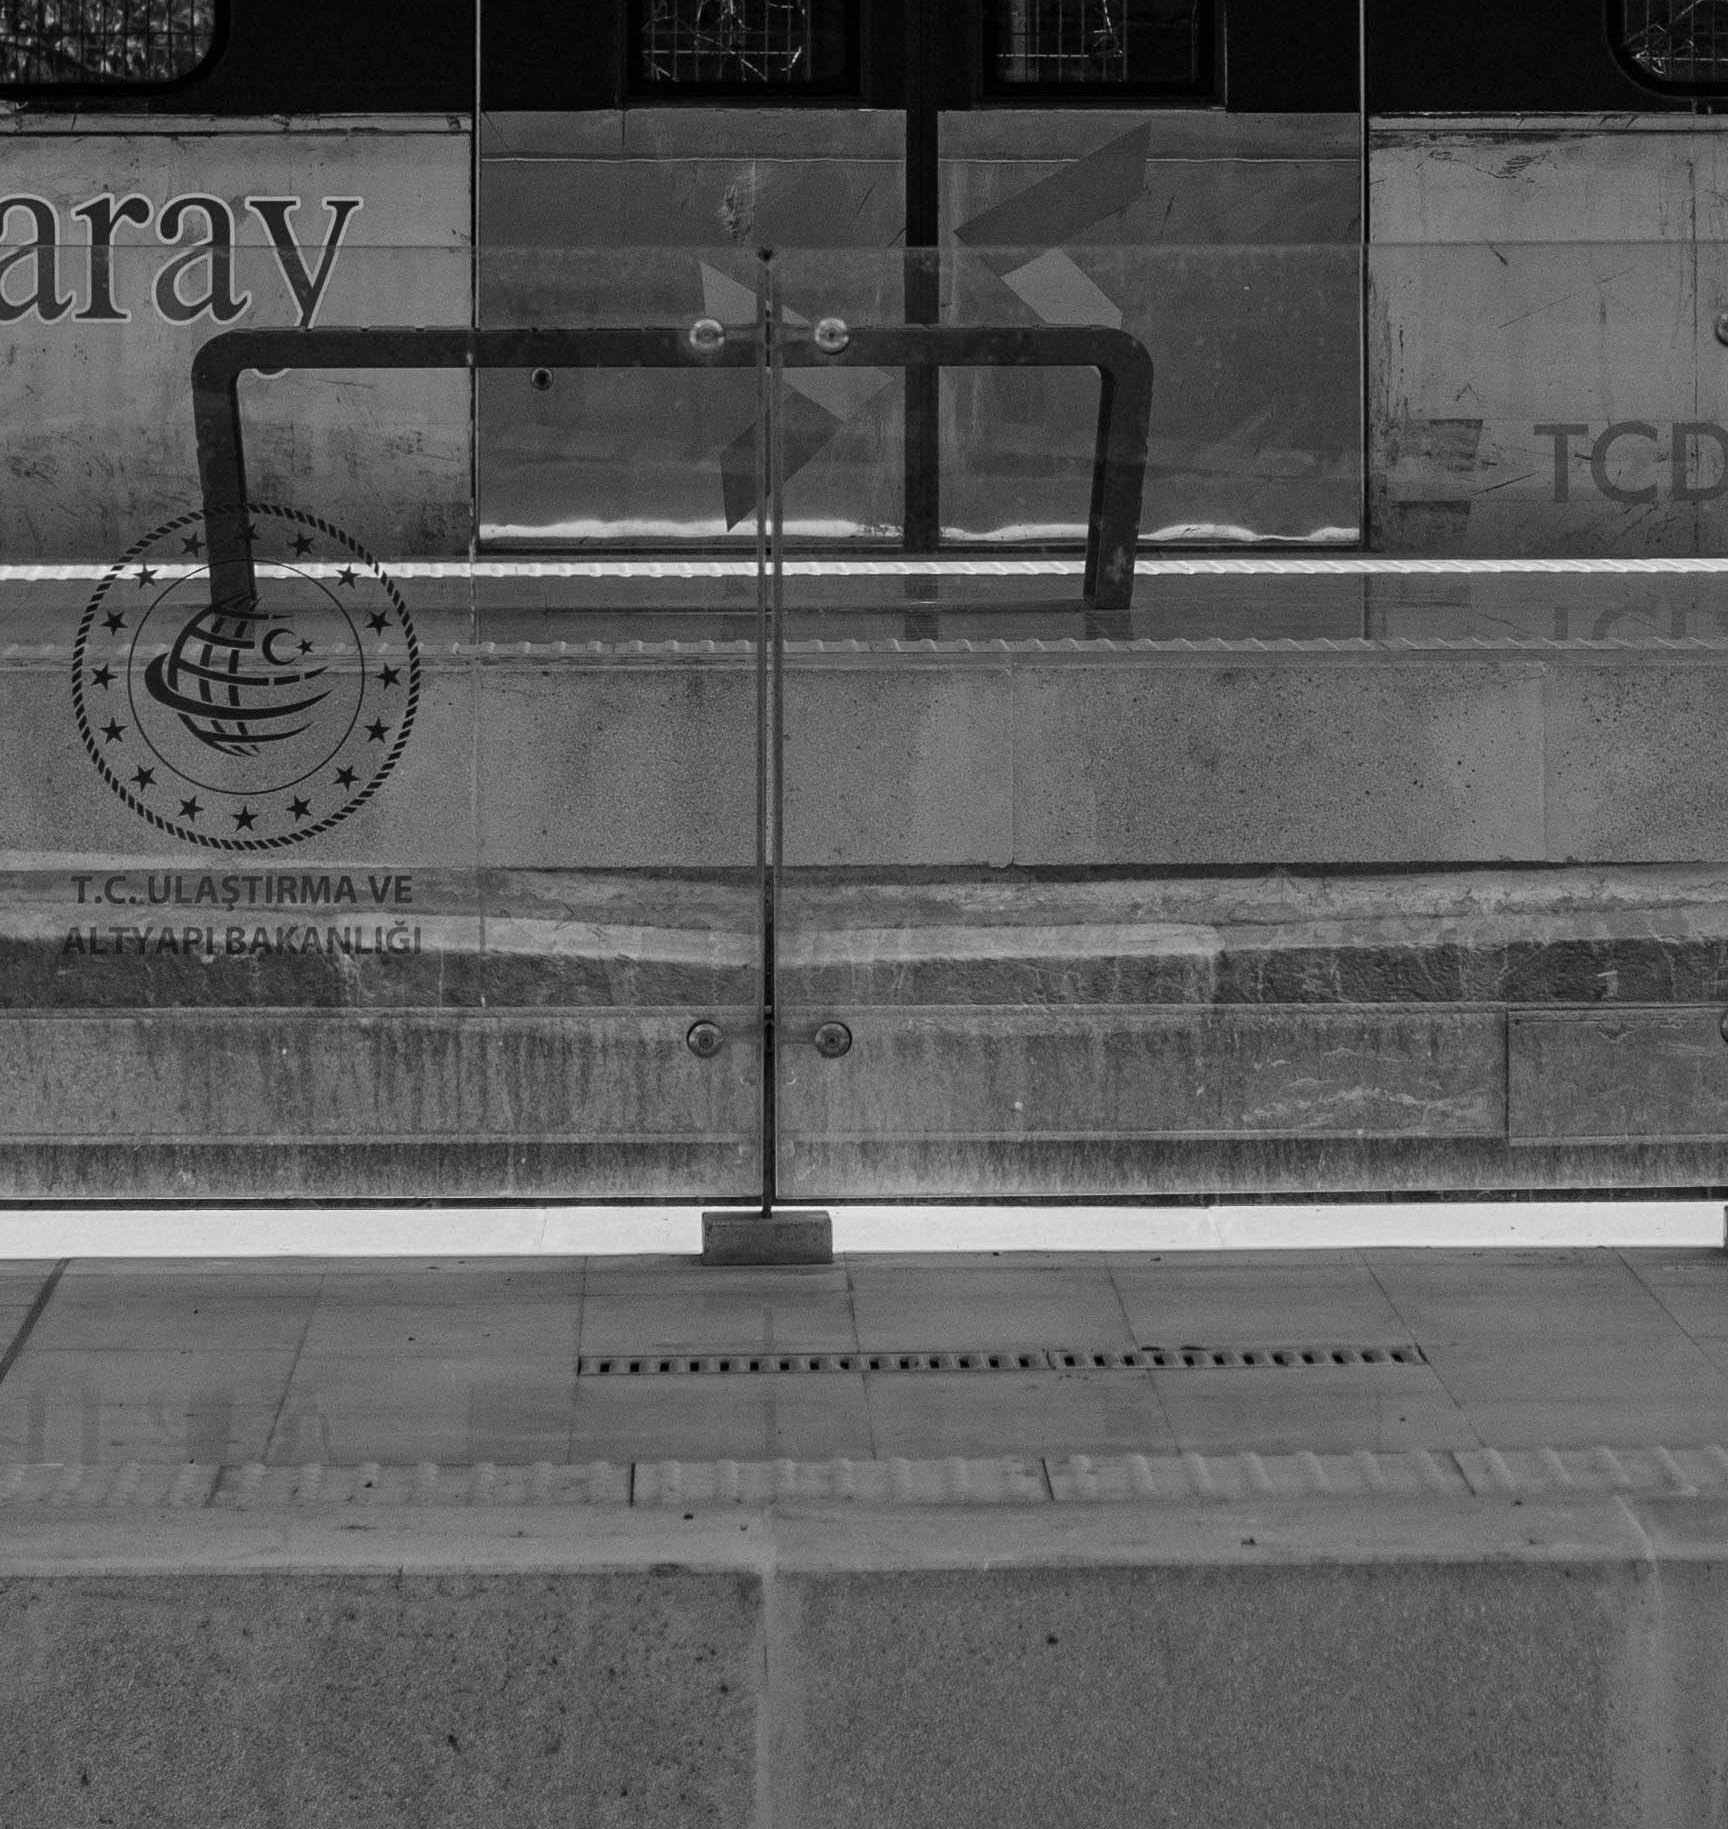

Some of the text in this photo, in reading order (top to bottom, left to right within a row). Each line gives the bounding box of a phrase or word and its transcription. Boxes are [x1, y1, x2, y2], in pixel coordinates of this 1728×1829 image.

[71, 875, 413, 911] T.C. ULAŞTIRMA VE
[62, 920, 422, 956] ALTYAPI BAKANLIĞI
